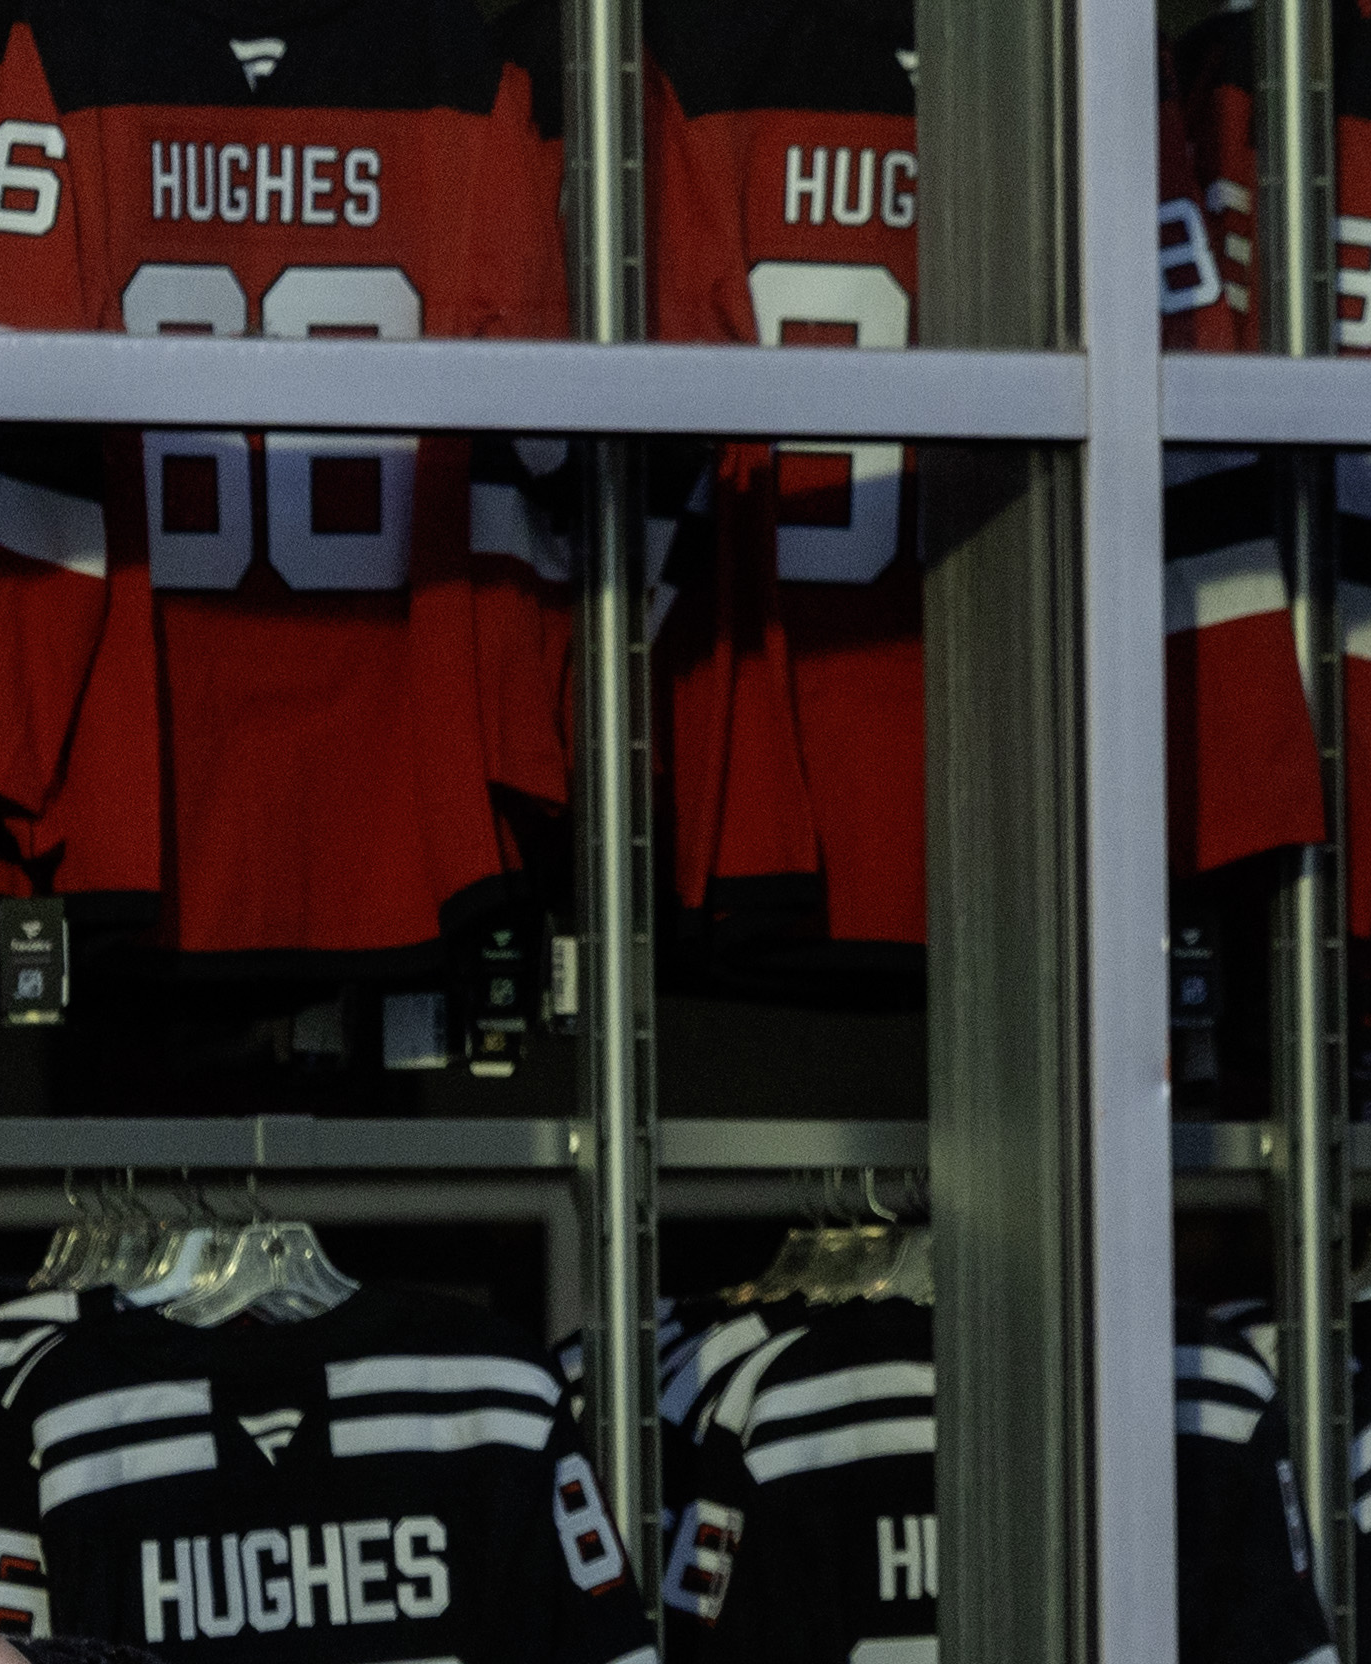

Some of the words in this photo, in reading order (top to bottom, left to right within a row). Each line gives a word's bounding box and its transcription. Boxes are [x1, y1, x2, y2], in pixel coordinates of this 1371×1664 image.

[151, 140, 382, 228] HUGHES
[784, 145, 918, 229] HUG
[554, 1453, 626, 1593] 8
[141, 1515, 451, 1643] HUGHES
